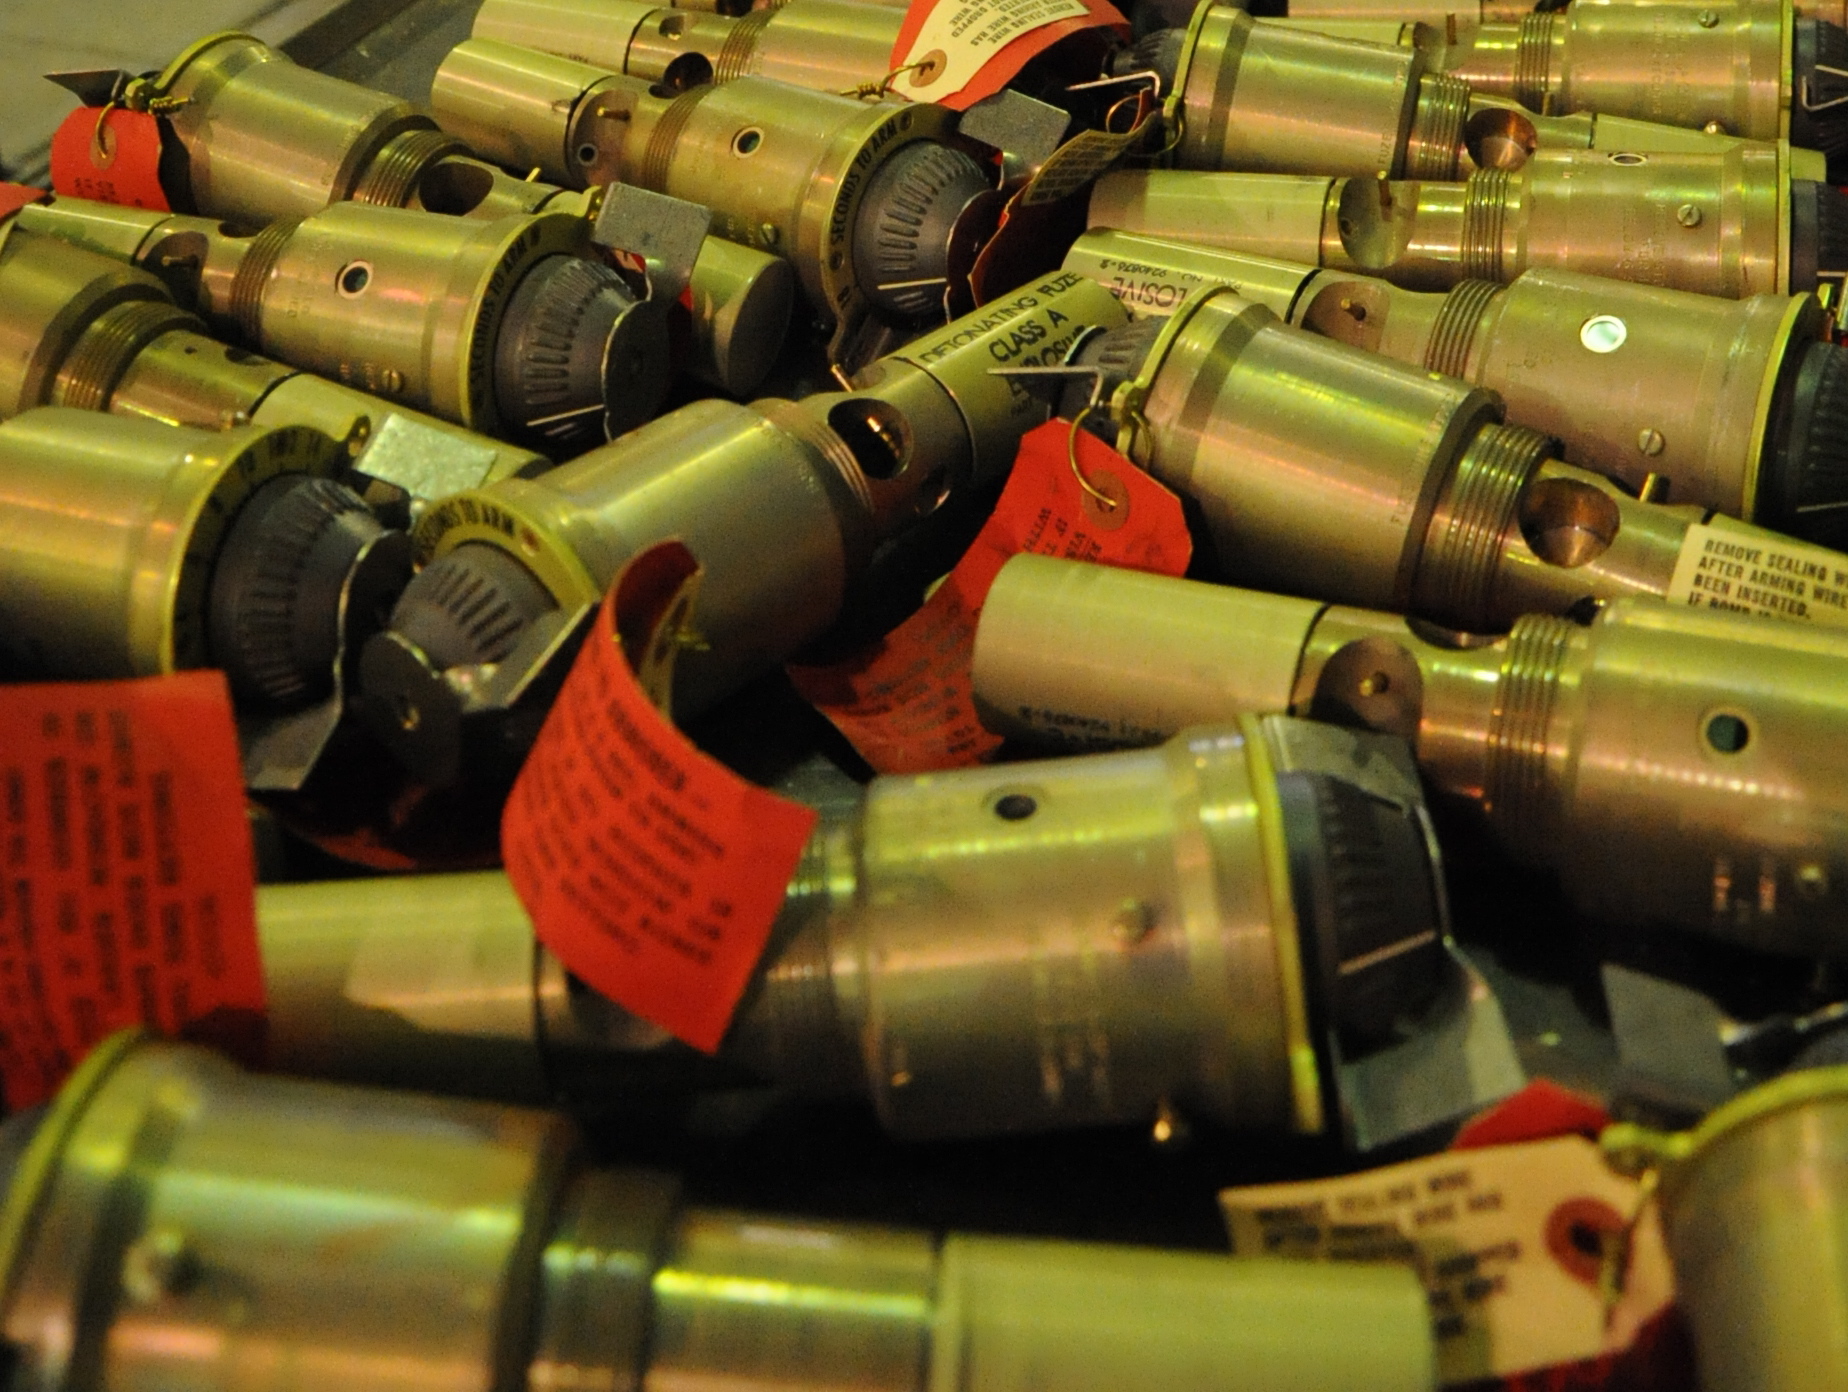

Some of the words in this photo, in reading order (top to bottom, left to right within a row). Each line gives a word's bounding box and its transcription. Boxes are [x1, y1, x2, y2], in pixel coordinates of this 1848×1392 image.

[949, 7, 973, 27] WIRE
[951, 7, 988, 38] DROPPED
[987, 15, 1012, 31] WIRE
[987, 26, 1012, 44] WIRE
[970, 31, 988, 47] HAS
[830, 172, 861, 245] SECONDS
[856, 151, 873, 170] TO
[871, 119, 898, 154] ARM
[503, 235, 527, 273] ARM
[918, 296, 1039, 364] DETONATING
[1036, 272, 1083, 300] FUZE
[988, 319, 1047, 363] CLASS
[1046, 308, 1069, 329] A
[1704, 539, 1762, 565] REMOVE
[1767, 553, 1828, 581] SEALING
[1688, 591, 1704, 606] IF
[1693, 573, 1730, 595] BEEN
[1737, 585, 1811, 619] INSERTED.
[1698, 556, 1744, 579] AFTER
[1749, 569, 1806, 596] ARMING
[1813, 586, 1848, 609] WIRE
